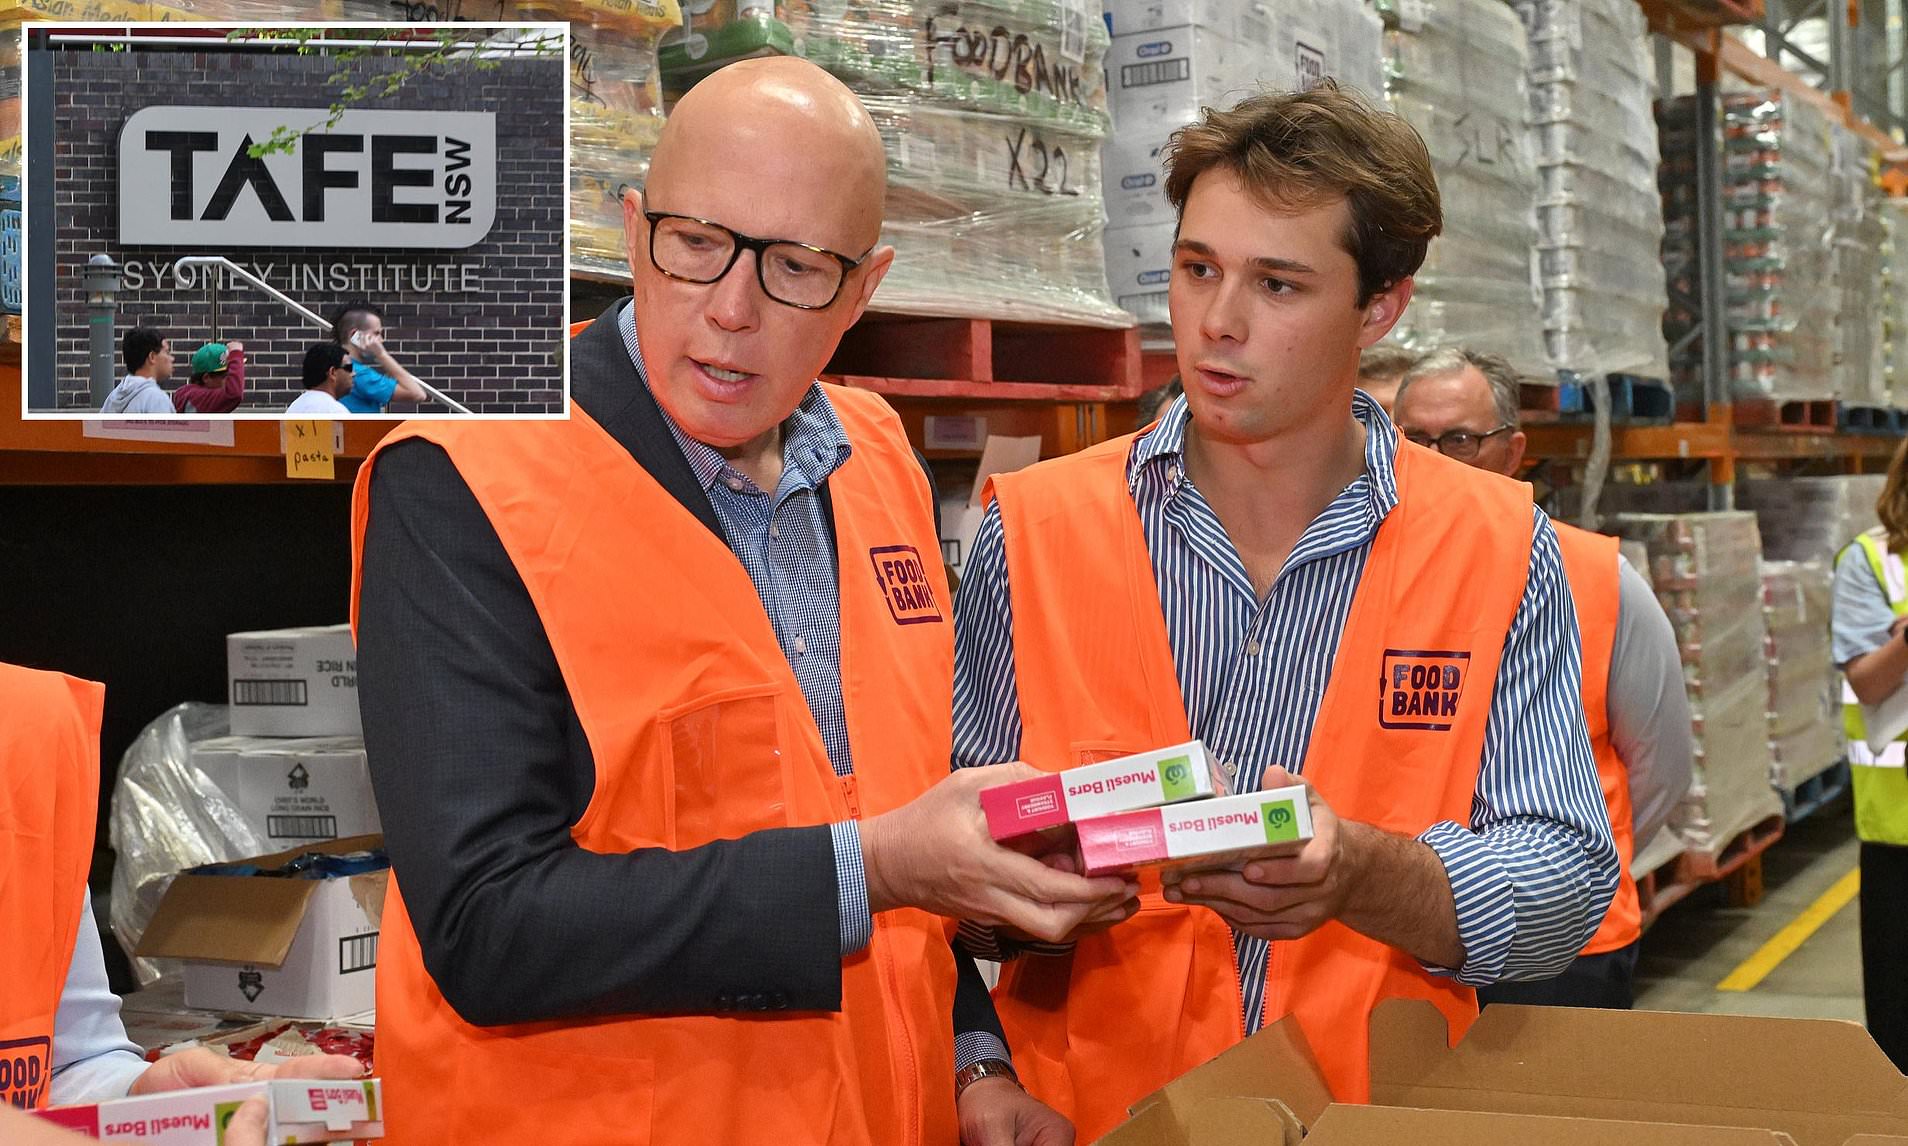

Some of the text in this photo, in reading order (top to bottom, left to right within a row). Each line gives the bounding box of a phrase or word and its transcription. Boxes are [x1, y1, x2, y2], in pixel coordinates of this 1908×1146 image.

[145, 130, 439, 223] TAFE
[445, 136, 472, 225] NSW
[123, 260, 481, 293] SYDNEY INSTITUTE
[294, 450, 329, 472] pasta
[1393, 664, 1461, 690] FOOD
[1391, 691, 1459, 717] BANK
[1068, 769, 1156, 796] Muesli Bars
[1168, 811, 1259, 833] Muesli Bars
[105, 1113, 209, 1136] Muesli Bars
